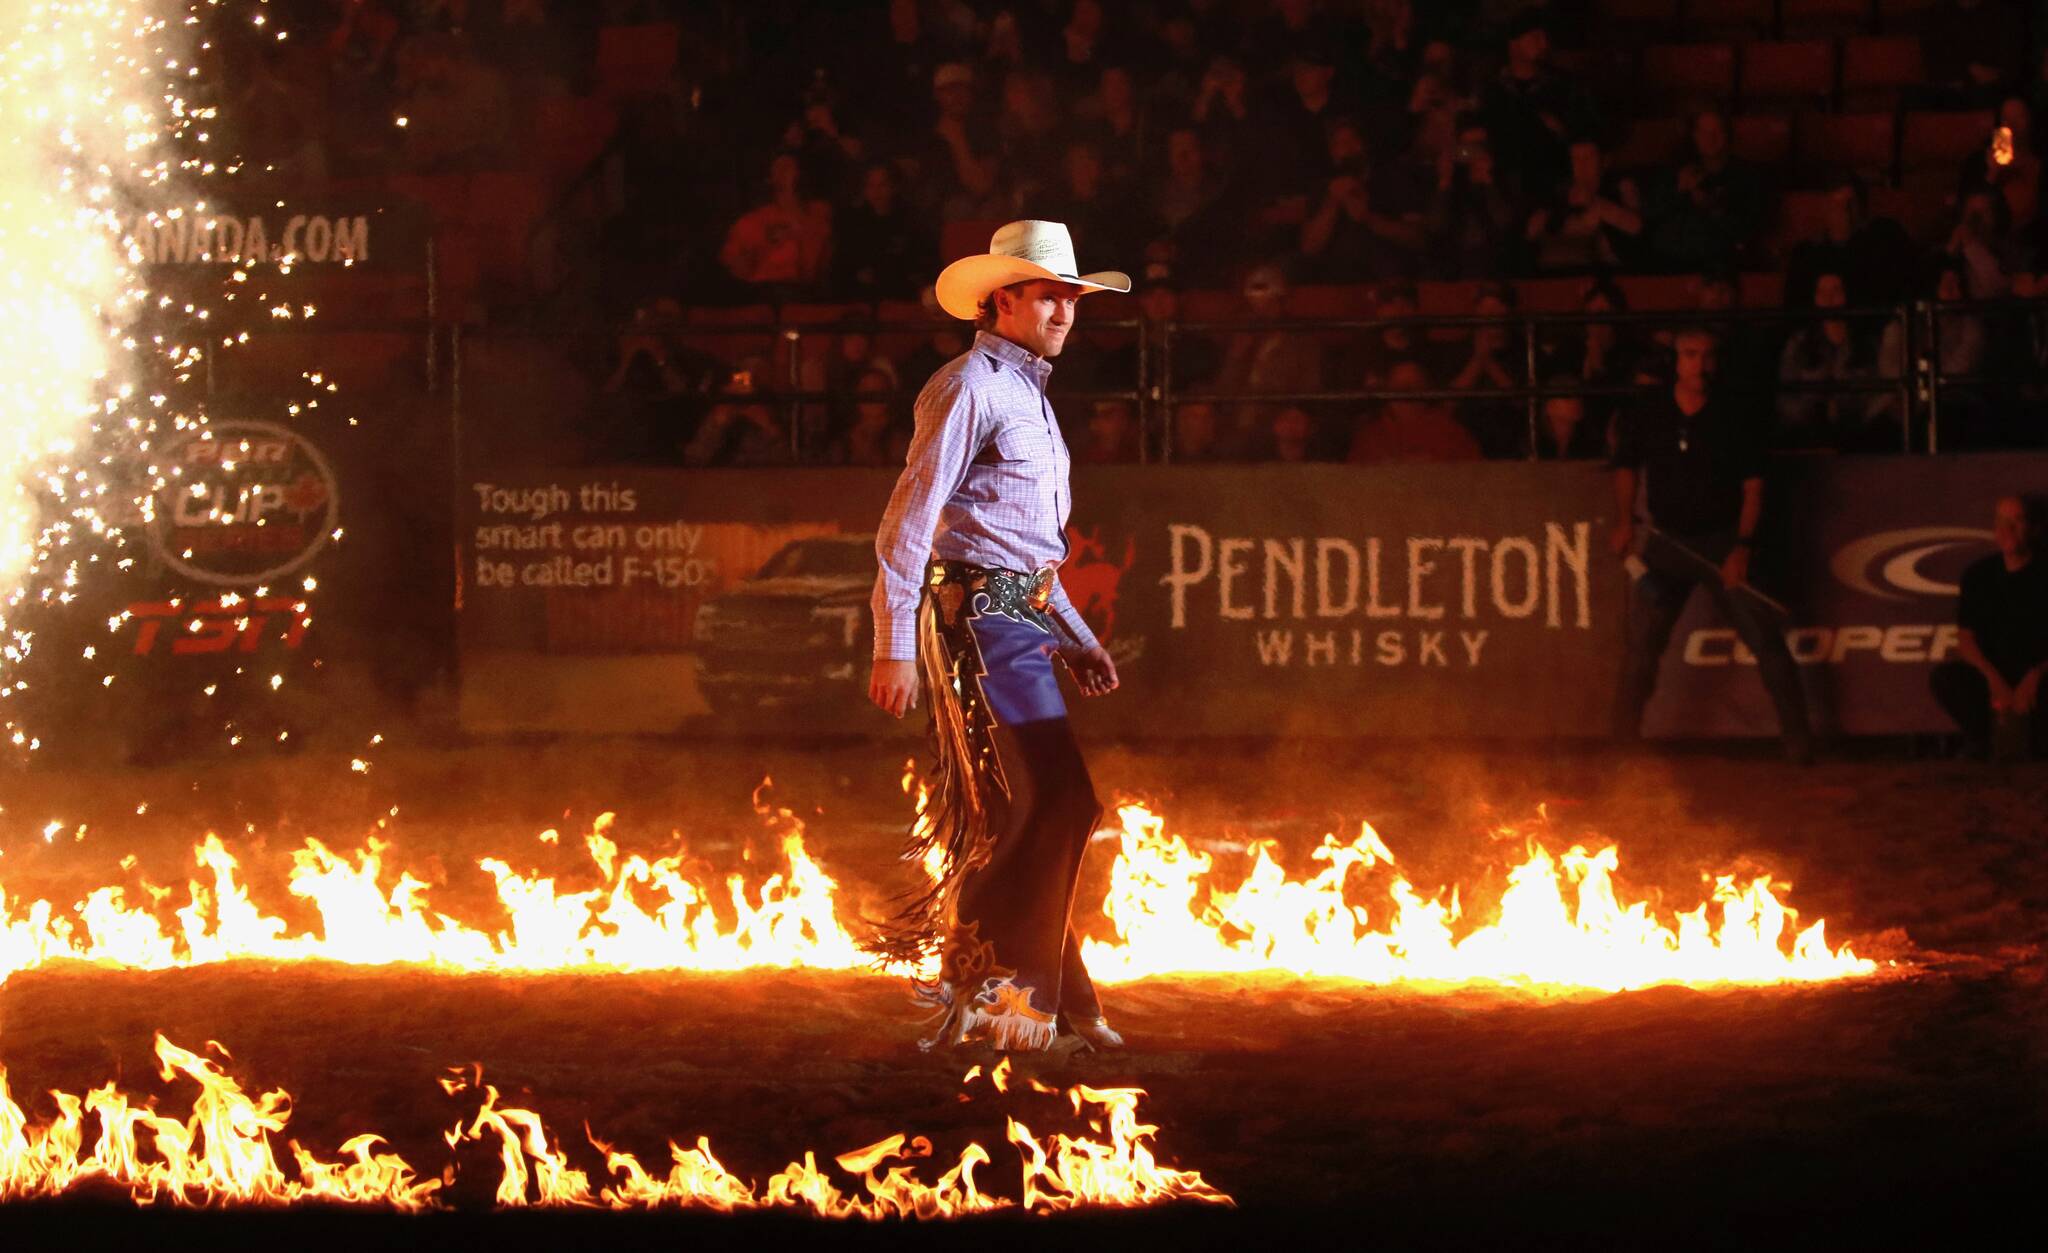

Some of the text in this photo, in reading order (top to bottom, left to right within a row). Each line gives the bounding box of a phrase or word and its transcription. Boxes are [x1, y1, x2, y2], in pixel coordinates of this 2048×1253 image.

[120, 215, 369, 263] ANADA.COM
[174, 484, 285, 526] CUP
[473, 481, 637, 520] Tough this
[474, 520, 701, 554] smart can only
[476, 556, 516, 586] be
[522, 555, 613, 587] called
[1160, 520, 1591, 628] PENDLETON
[127, 598, 313, 655] TSN
[1257, 630, 1489, 666] WHISKY
